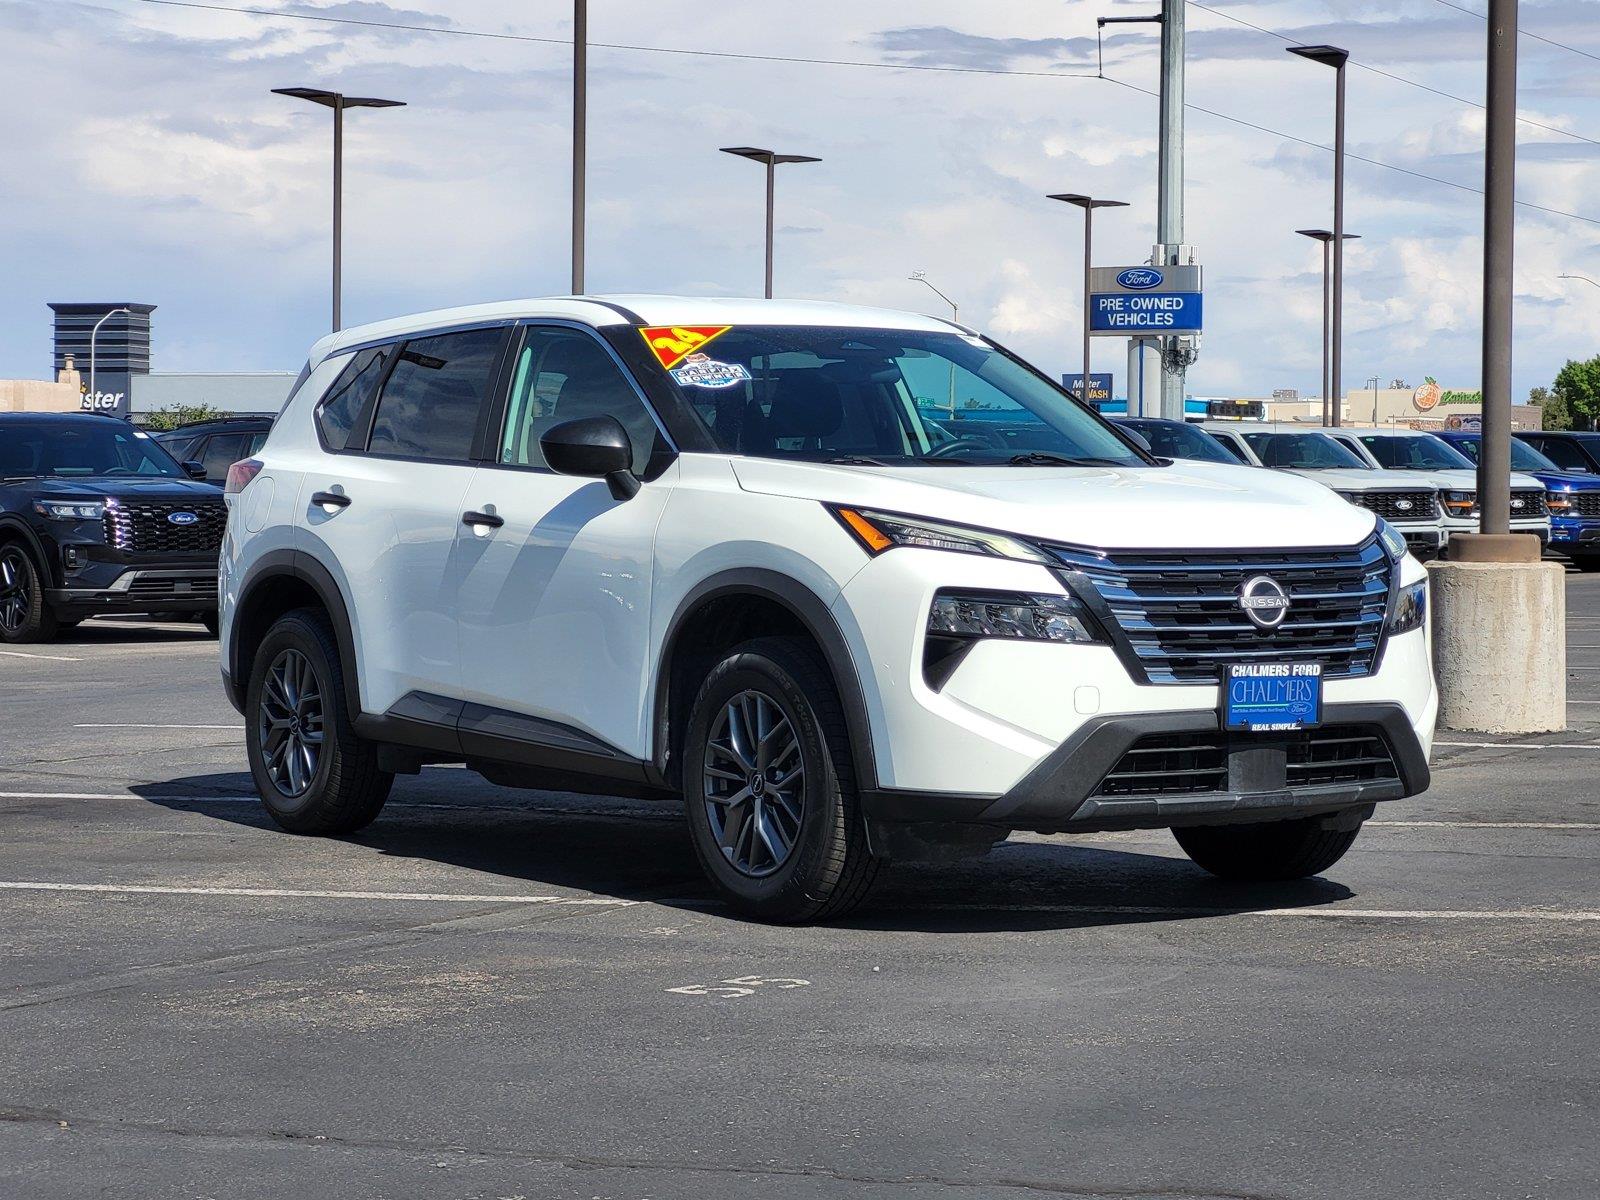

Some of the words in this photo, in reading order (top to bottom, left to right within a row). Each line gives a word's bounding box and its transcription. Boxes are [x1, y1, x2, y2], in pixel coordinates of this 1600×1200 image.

[1125, 271, 1153, 285] Ford
[1099, 297, 1184, 311] PRE-OWNED
[1107, 313, 1174, 326] VEHICLES
[652, 327, 707, 354] 24
[677, 366, 740, 378] CARFAX
[691, 372, 744, 382] OWNER
[1072, 379, 1102, 389] Miter
[1241, 597, 1290, 608] NISSAN
[1231, 664, 1289, 677] CHALMERS
[1292, 664, 1321, 676] FORD
[1232, 679, 1312, 703] CHALMERS
[1291, 703, 1308, 713] Ford
[1251, 723, 1270, 731] REAL
